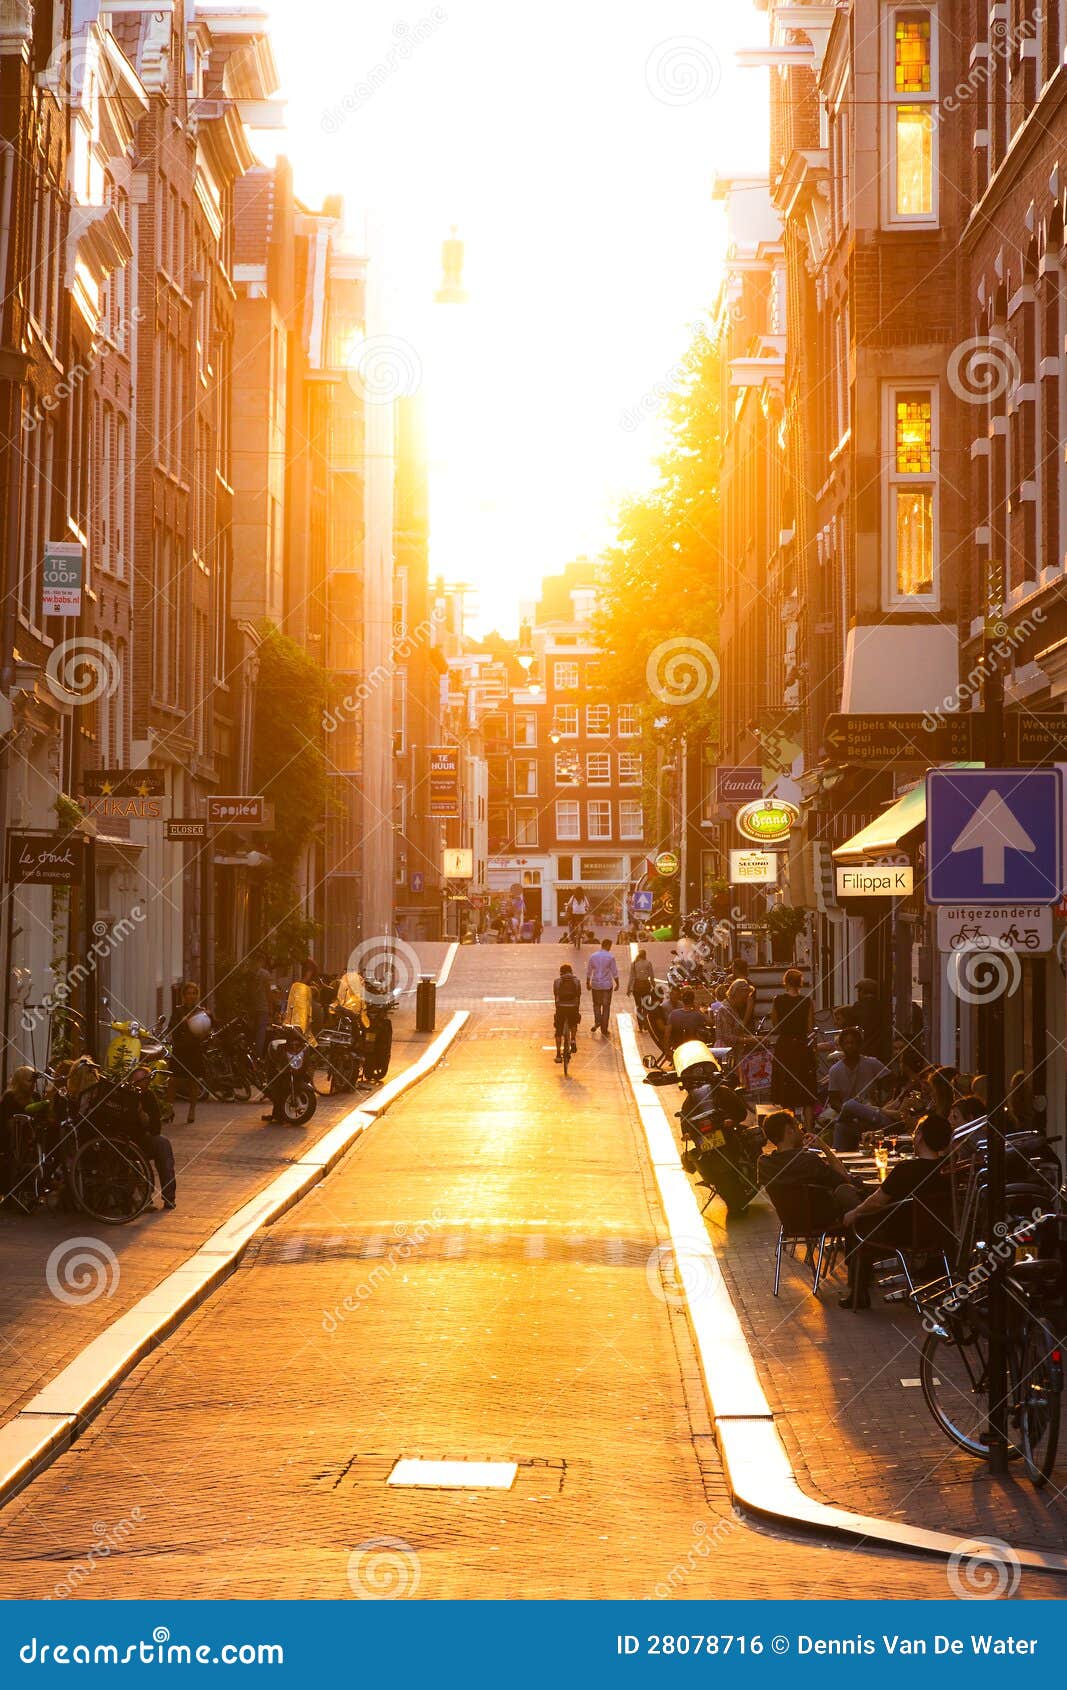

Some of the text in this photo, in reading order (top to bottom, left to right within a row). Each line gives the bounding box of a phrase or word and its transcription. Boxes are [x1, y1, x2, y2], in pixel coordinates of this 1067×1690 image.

[50, 559, 67, 571] TE
[847, 720, 885, 732] Bijbels
[847, 733, 872, 744] Spui
[1022, 733, 1049, 742] Anne
[847, 746, 900, 757] Begijnhof
[438, 754, 449, 762] TE
[431, 762, 456, 770] HUUR
[87, 800, 162, 818] KIKAIS
[212, 803, 258, 818] Spoiled
[751, 812, 789, 828] Brand
[171, 826, 204, 834] CLOSED
[738, 866, 768, 876] BEST
[843, 873, 906, 892] Filippa K
[947, 908, 1041, 921] uitgezonderd
